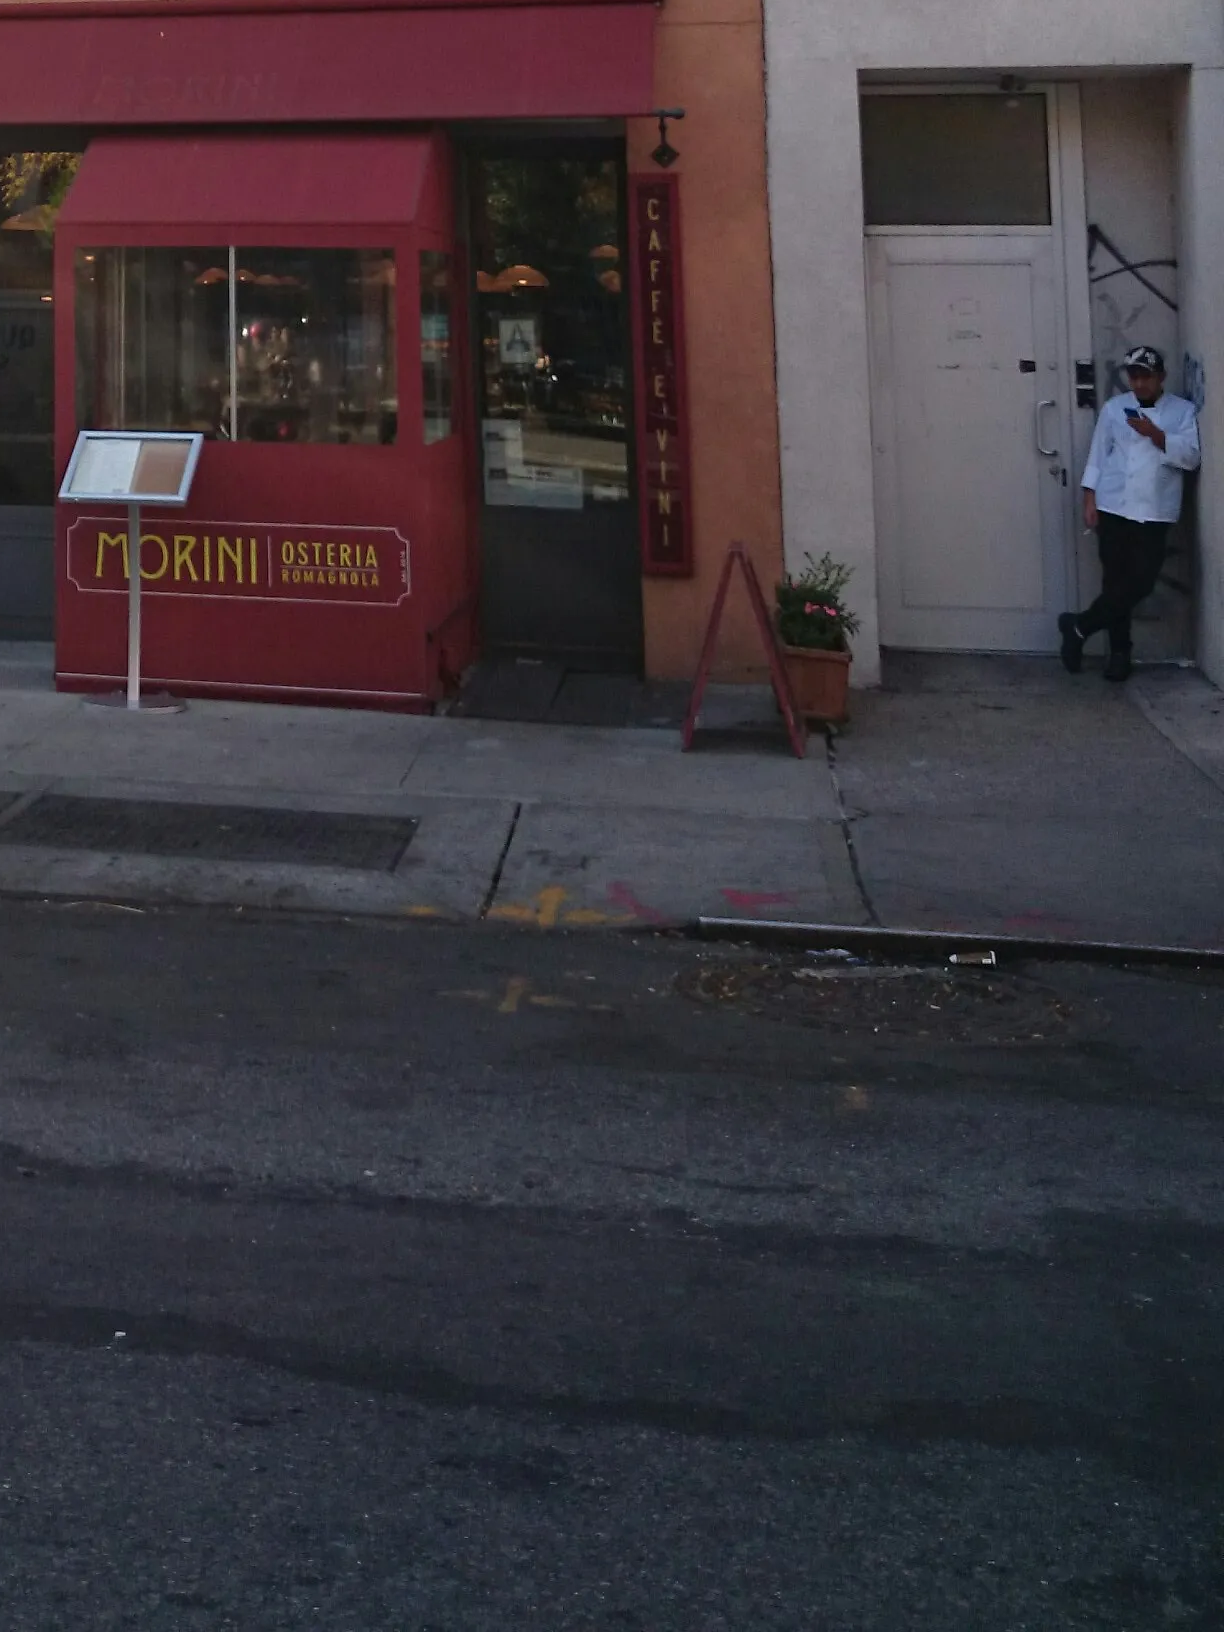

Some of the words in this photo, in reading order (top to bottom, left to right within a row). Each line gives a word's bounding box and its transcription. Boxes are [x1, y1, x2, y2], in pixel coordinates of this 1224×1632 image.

[656, 427, 671, 547] VINI
[95, 531, 258, 585] MORINI
[281, 540, 378, 568] OSTERIA
[281, 568, 380, 586] ROMAGNOLA
